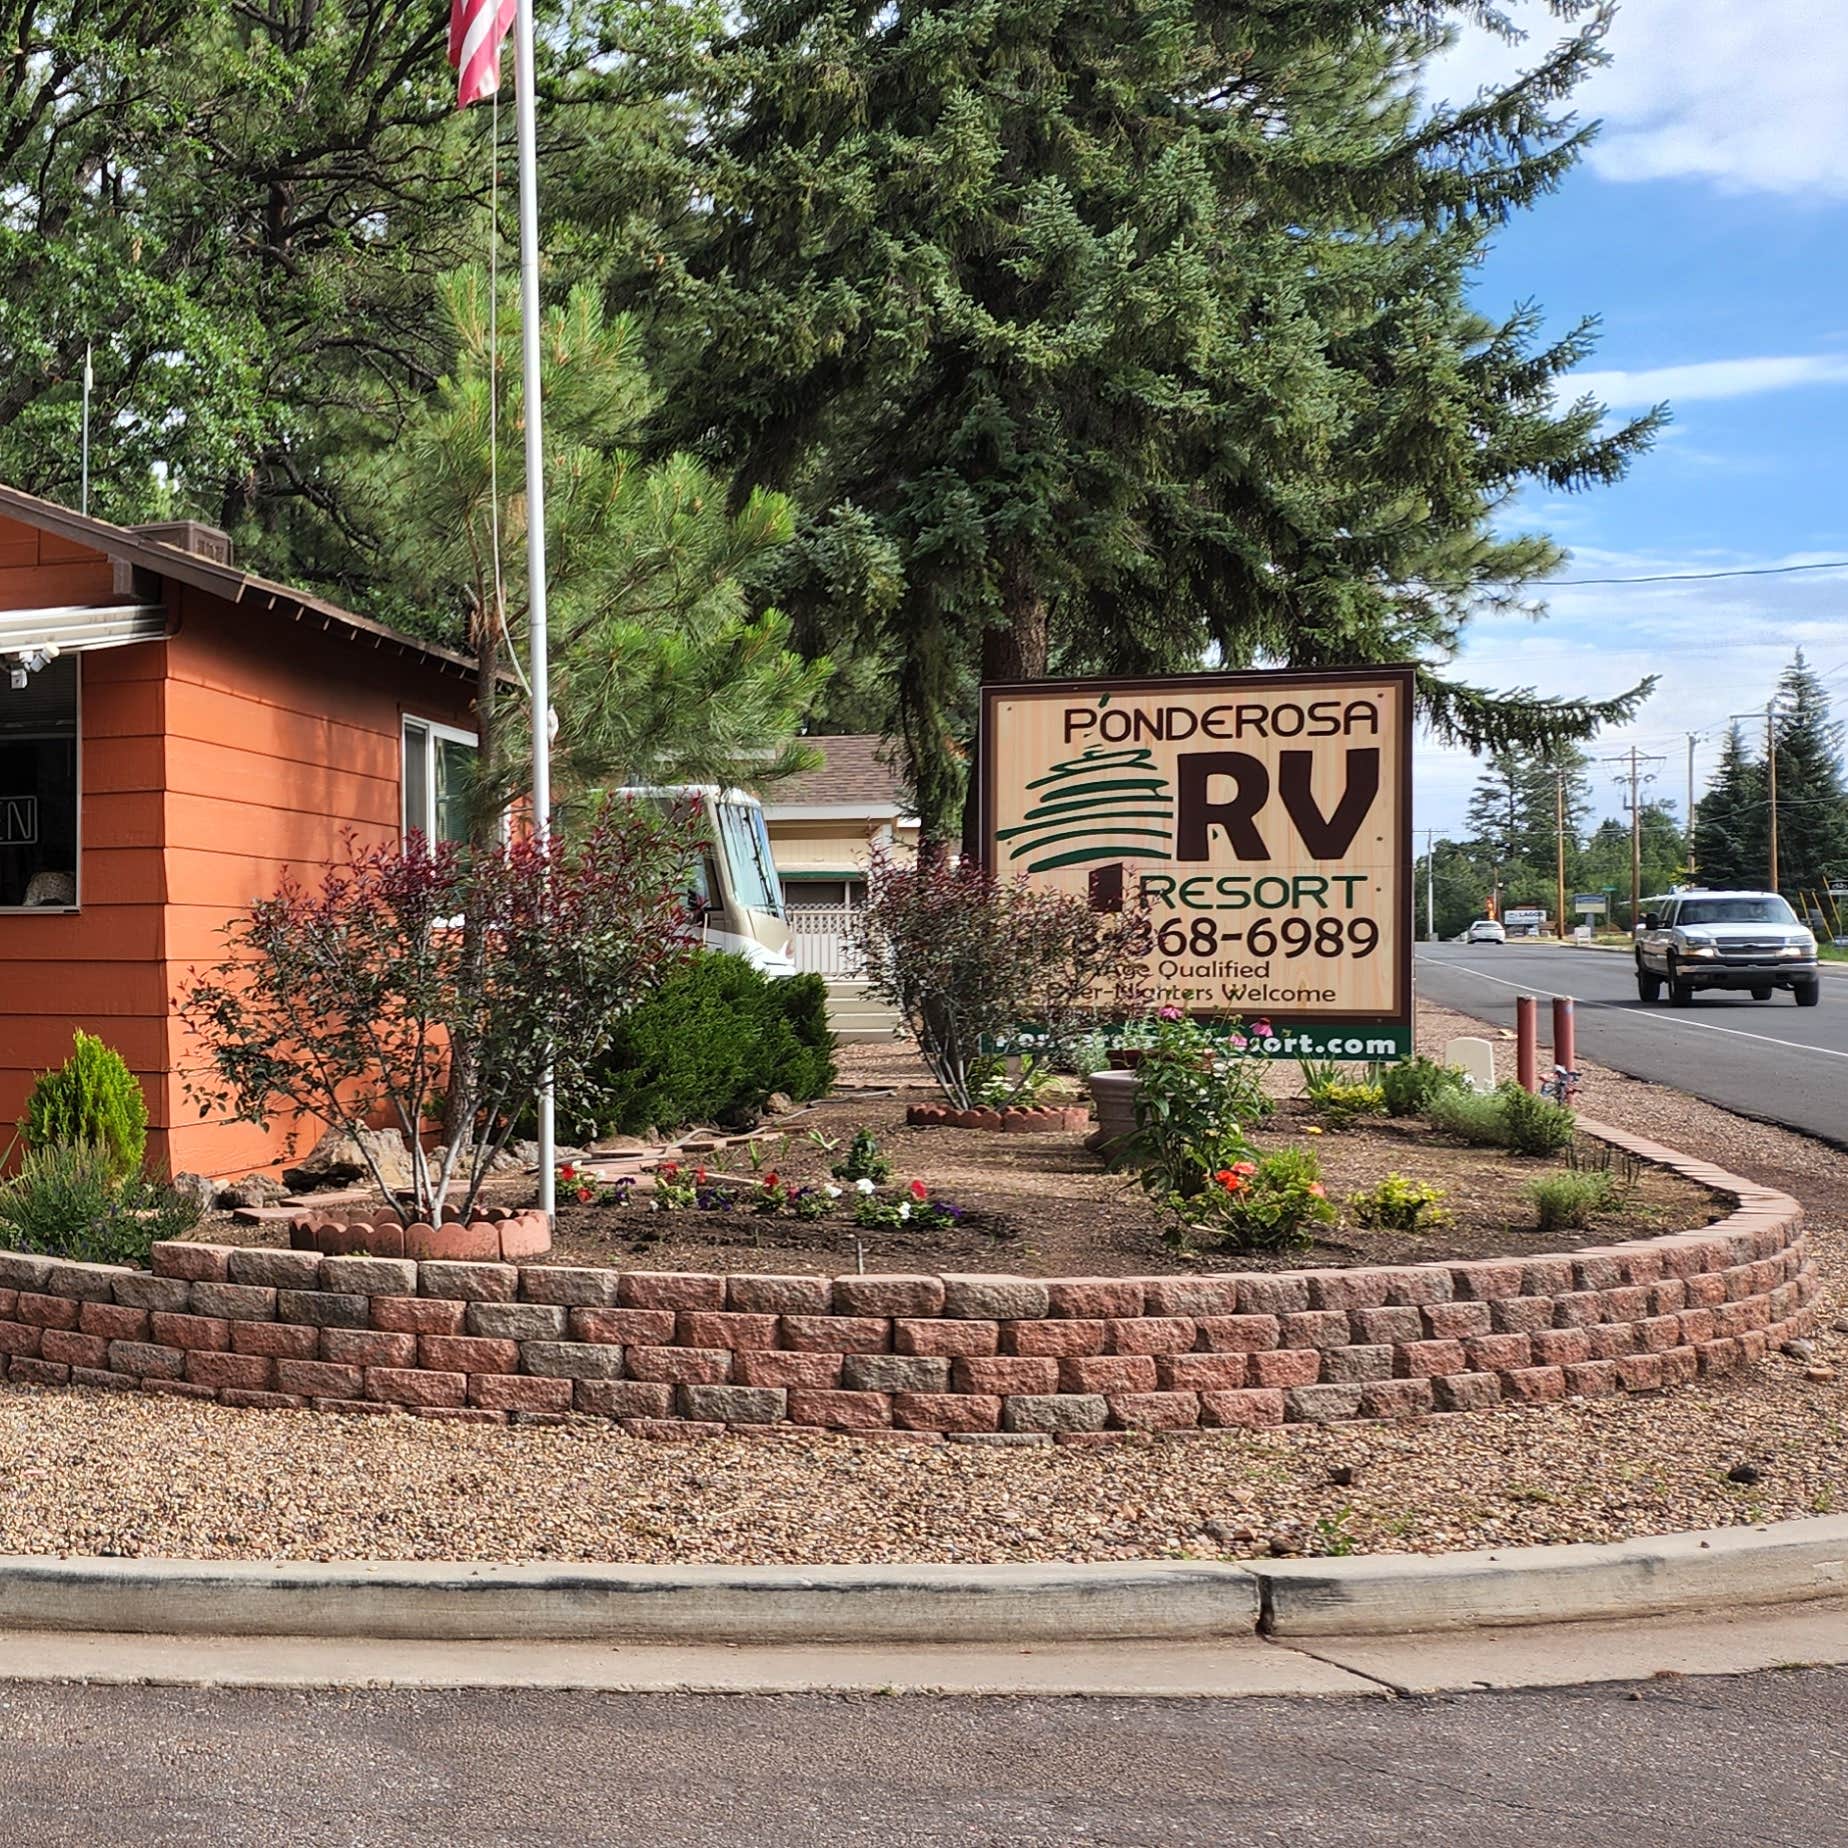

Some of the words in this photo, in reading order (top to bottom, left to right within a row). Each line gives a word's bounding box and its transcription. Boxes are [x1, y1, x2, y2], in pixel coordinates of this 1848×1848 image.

[1064, 701, 1378, 744] PONDEROSA
[1177, 747, 1380, 862] RV
[1139, 874, 1368, 910] RESORT
[1158, 959, 1270, 980] Qualified
[1221, 982, 1336, 1002] Welcome
